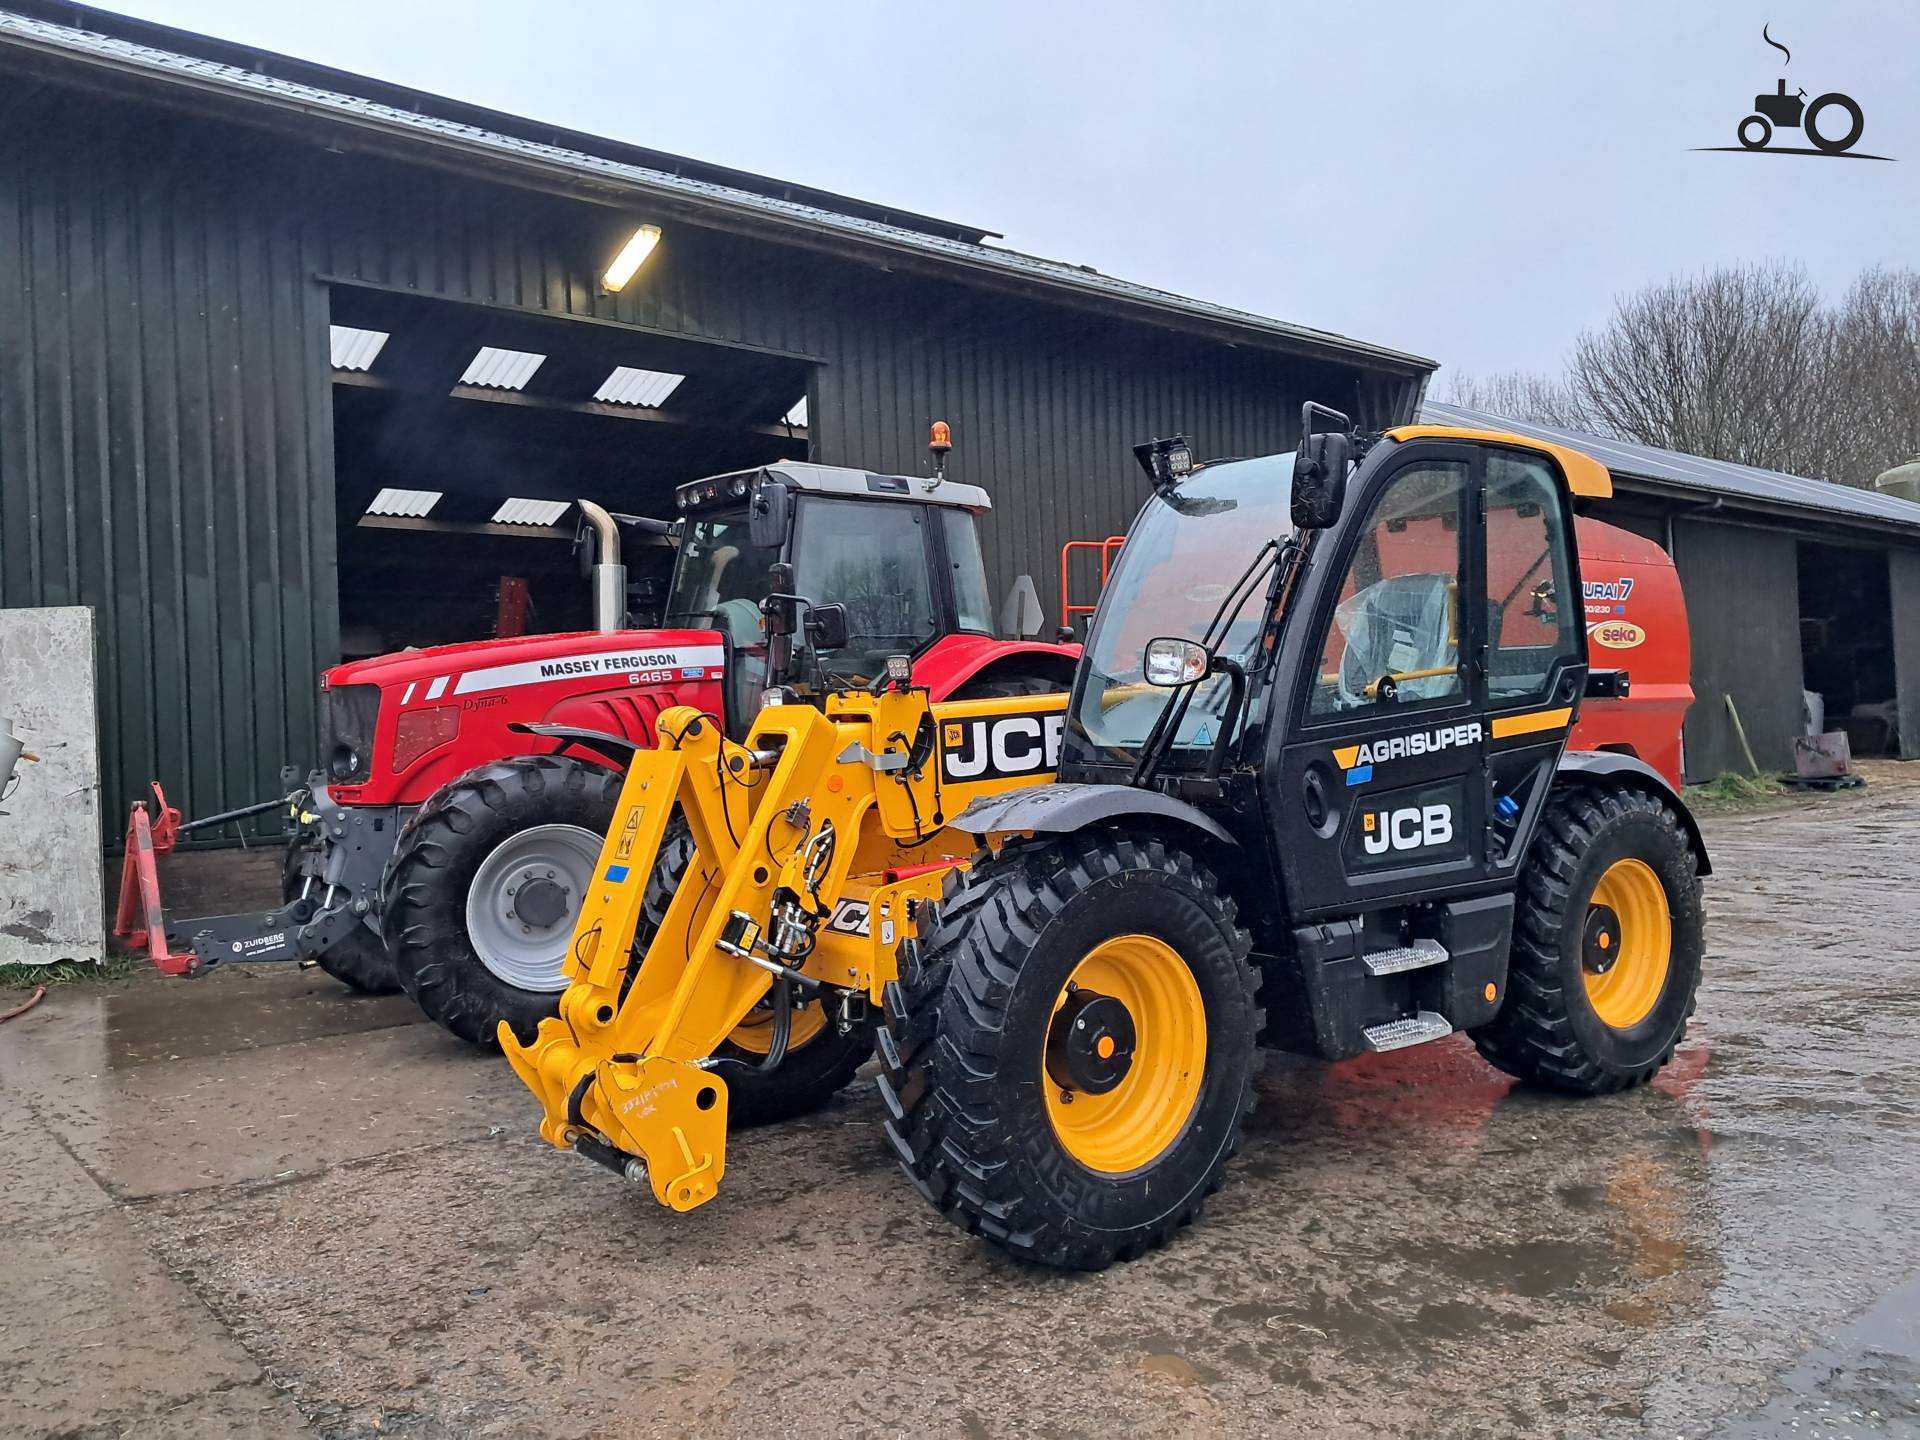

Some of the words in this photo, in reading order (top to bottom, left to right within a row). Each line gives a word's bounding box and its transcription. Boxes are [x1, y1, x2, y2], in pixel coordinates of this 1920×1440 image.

[1582, 581, 1618, 600] URAI
[1619, 577, 1634, 600] 7
[1602, 627, 1637, 642] seko
[540, 659, 600, 678] MASSEY
[604, 653, 677, 670] FERGUSON
[628, 670, 673, 684] 6465
[463, 695, 508, 712] Dyna-6
[1356, 722, 1483, 766] AGRISUPER
[1363, 804, 1454, 854] JCB
[243, 932, 285, 948] ZUIDBERG
